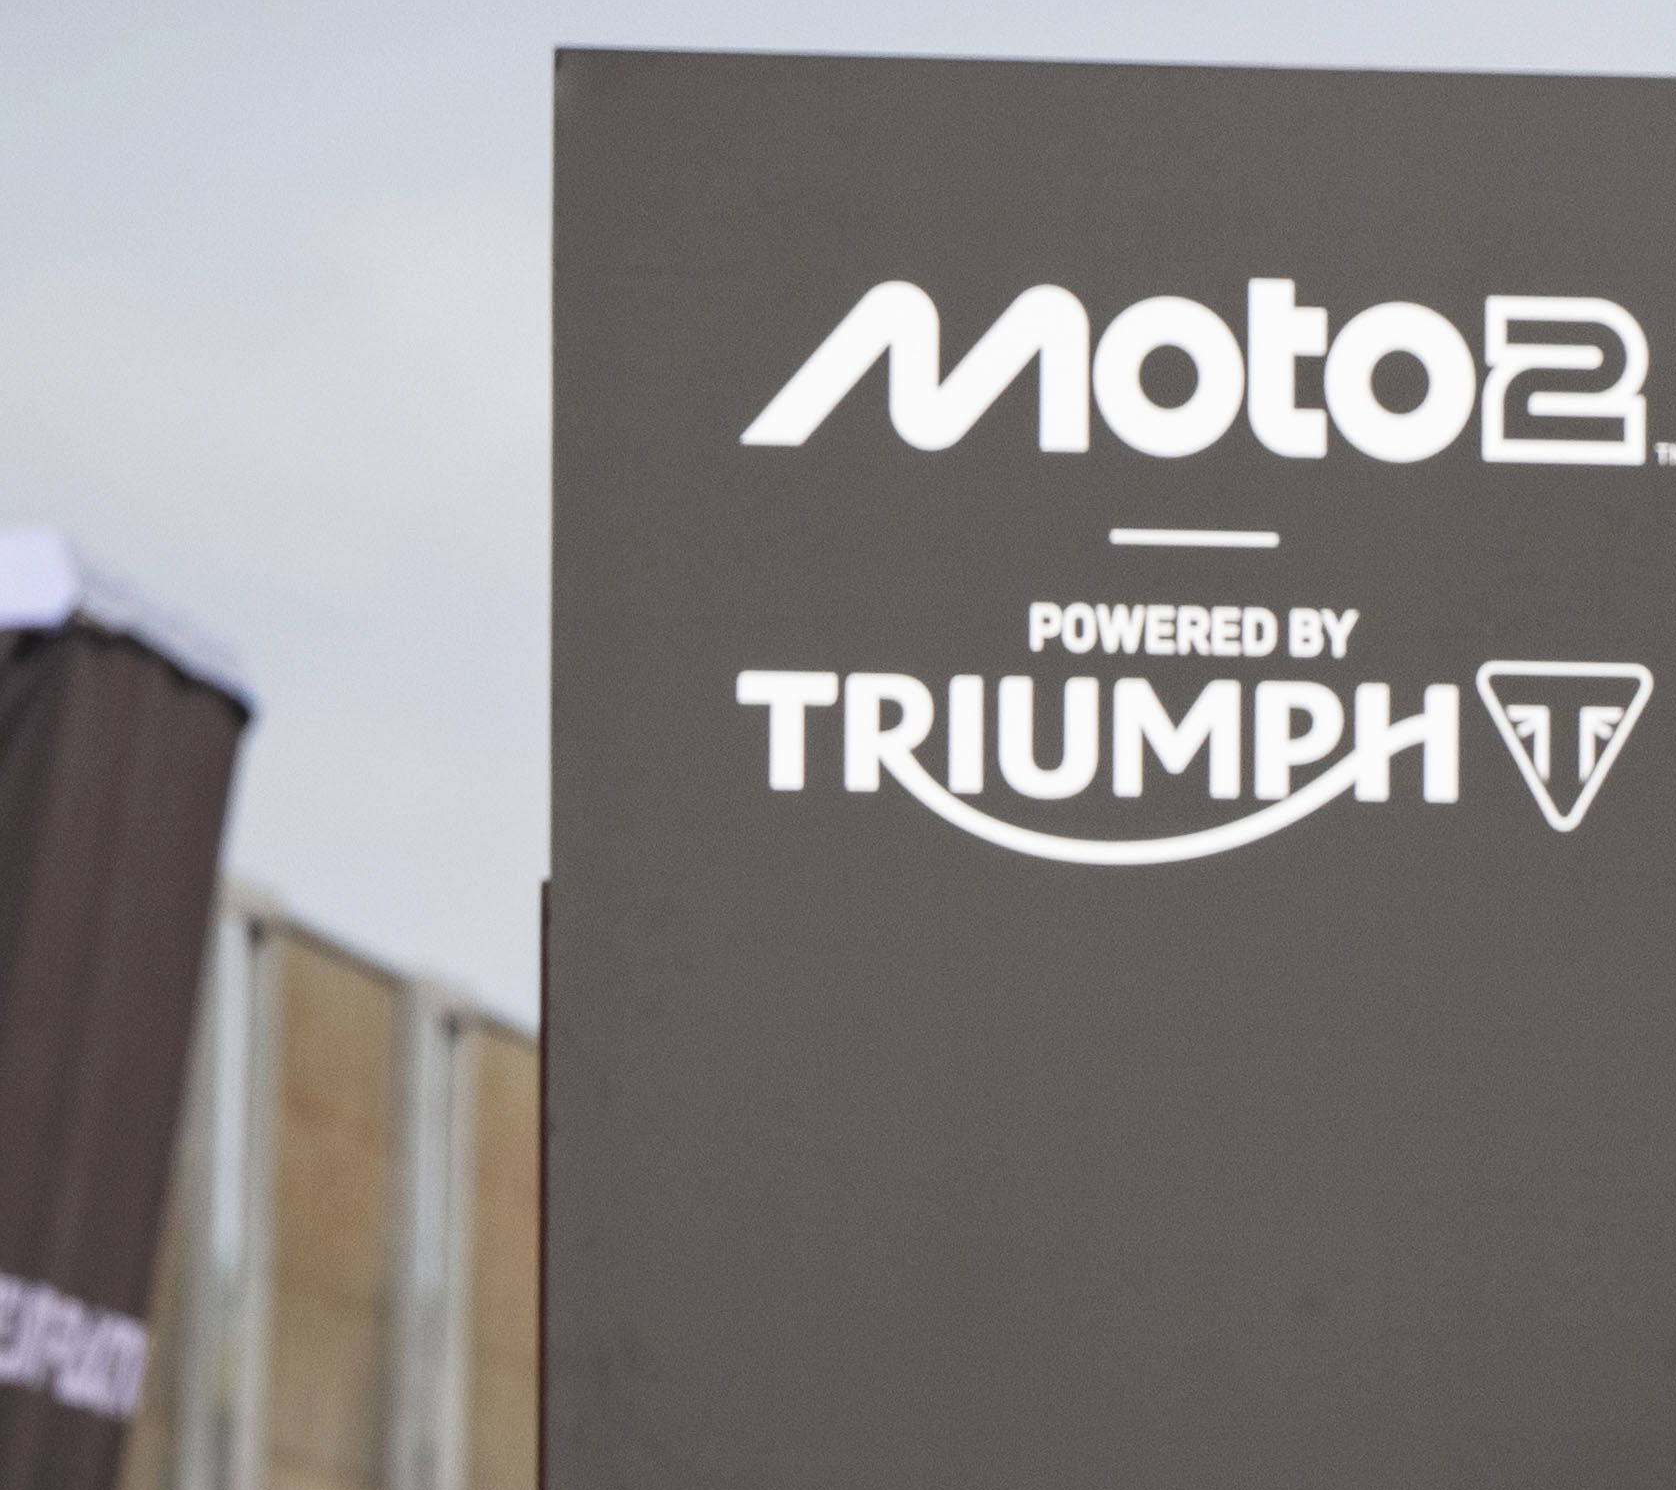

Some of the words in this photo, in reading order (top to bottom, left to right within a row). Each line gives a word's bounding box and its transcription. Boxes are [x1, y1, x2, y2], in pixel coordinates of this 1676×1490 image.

[739, 277, 1649, 464] Moto2
[1027, 602, 1279, 656] POWERED
[1288, 606, 1359, 658] BY
[736, 670, 1460, 864] TRIUMPH
